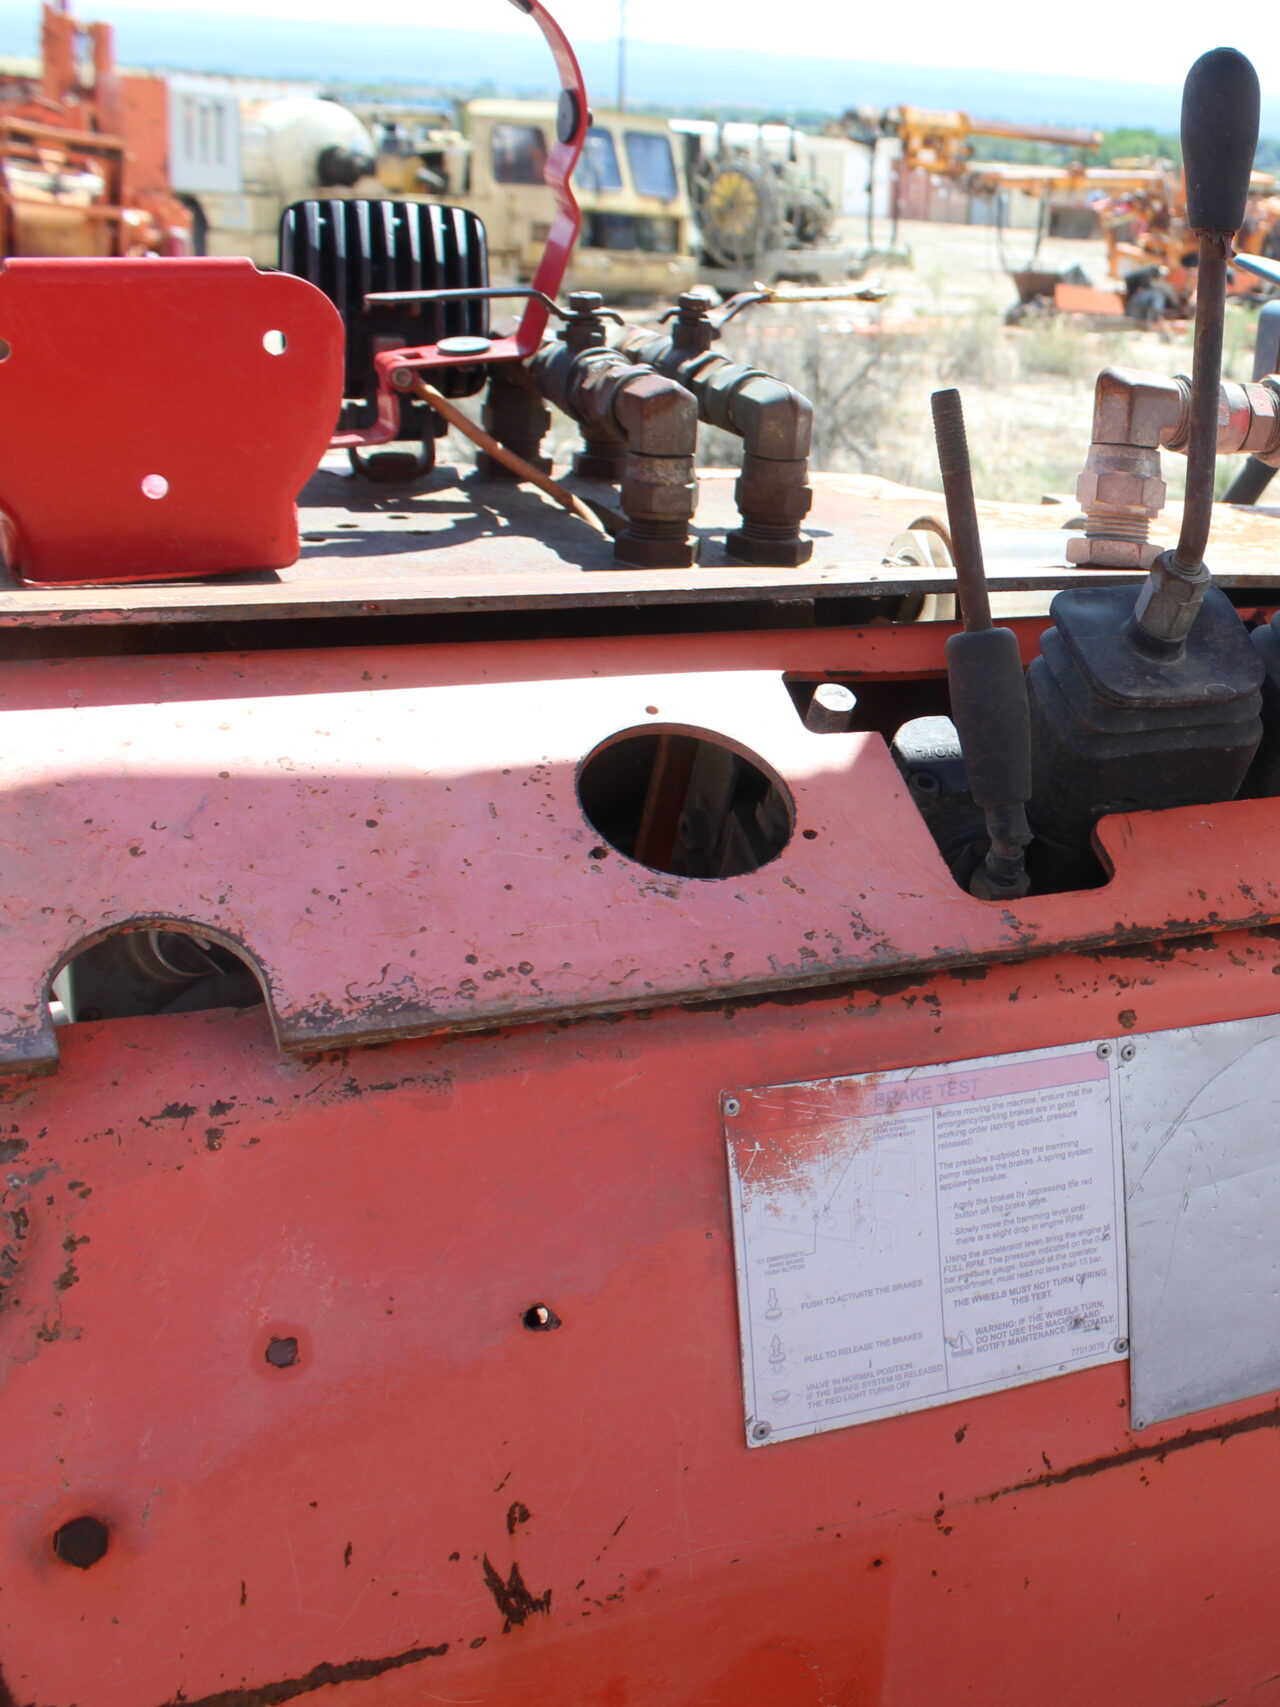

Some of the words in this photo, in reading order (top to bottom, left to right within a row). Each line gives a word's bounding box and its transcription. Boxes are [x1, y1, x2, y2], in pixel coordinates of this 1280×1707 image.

[873, 1084, 932, 1107] BRAKE
[936, 1077, 979, 1098] TEST
[936, 1108, 961, 1119] Before
[963, 1103, 990, 1116] moving
[991, 1101, 1004, 1110] the
[1066, 1089, 1079, 1098] that
[1080, 1086, 1093, 1095] the
[936, 1111, 1008, 1130] emergency/parking
[1009, 1107, 1033, 1117] brakes
[1048, 1103, 1056, 1111] in
[1057, 1100, 1076, 1110] good
[937, 1128, 966, 1141] working
[967, 1123, 988, 1134] order
[989, 1119, 1015, 1132] (spring
[1046, 1110, 1078, 1122] pressure
[937, 1159, 953, 1170] The
[954, 1154, 988, 1168] pressure
[989, 1148, 1020, 1162] supplied
[1020, 1146, 1030, 1157] by
[1031, 1144, 1044, 1153] the
[1044, 1138, 1079, 1152] tramming
[938, 1170, 961, 1182] pump
[961, 1163, 993, 1176] releases
[994, 1161, 1007, 1170] the
[1036, 1154, 1044, 1162] A
[1043, 1151, 1065, 1163] spring
[1067, 1146, 1093, 1159] system
[952, 1198, 974, 1212] Apply
[975, 1196, 988, 1206] the
[989, 1191, 1015, 1203] brakes
[1016, 1189, 1026, 1200] by
[1026, 1181, 1065, 1197] depressing
[1067, 1178, 1079, 1189] the
[1080, 1176, 1093, 1186] red
[968, 1176, 980, 1186] the
[954, 1208, 978, 1220] button
[979, 1206, 990, 1215] on
[991, 1203, 1003, 1213] the
[1004, 1199, 1026, 1210] brake
[954, 1223, 979, 1237] Slowly
[980, 1220, 1002, 1231] move
[1002, 1217, 1015, 1226] the
[1016, 1210, 1050, 1225] tramming
[1051, 1206, 1069, 1217] lever
[1071, 1203, 1086, 1213] until
[945, 1251, 967, 1265] Using
[968, 1249, 981, 1259] the
[982, 1240, 1023, 1256] accelerator
[1045, 1232, 1063, 1244] bring
[1064, 1229, 1077, 1239] the
[1077, 1225, 1102, 1238] engine
[955, 1234, 976, 1245] there
[977, 1232, 984, 1241] is
[992, 1227, 1012, 1240] slight
[1012, 1224, 1030, 1236] drop
[1031, 1222, 1038, 1231] in
[1039, 1218, 1064, 1230] engine
[943, 1262, 964, 1274] FULL
[988, 1253, 1003, 1265] The
[1004, 1249, 1036, 1263] pressure
[1037, 1241, 1069, 1255] indicated
[1070, 1239, 1080, 1248] on
[1081, 1236, 1093, 1246] the
[1094, 1232, 1111, 1243] 0-5
[943, 1274, 955, 1284] bar
[957, 1267, 990, 1282] pressure
[1018, 1256, 1045, 1269] located
[1046, 1255, 1054, 1263] at
[1055, 1252, 1067, 1261] the
[1068, 1246, 1097, 1259] operator
[953, 1296, 969, 1307] THE
[971, 1288, 1007, 1304] WHEELS
[1009, 1283, 1032, 1296] MUST
[1033, 1279, 1051, 1290] NOT
[1052, 1274, 1074, 1286] TURN
[1075, 1267, 1106, 1282] DURING
[996, 1273, 1015, 1284] must
[1016, 1269, 1032, 1279] read
[1034, 1267, 1044, 1275] no
[1045, 1263, 1060, 1273] less
[1061, 1259, 1077, 1270] than
[800, 1298, 823, 1311] PUSH
[825, 1296, 835, 1305] TO
[836, 1288, 874, 1303] ACTIVATE
[874, 1285, 891, 1295] THE
[891, 1278, 923, 1292] BRAKES
[1010, 1294, 1029, 1306] THIS
[1031, 1288, 1053, 1301] TEST.
[974, 1319, 1016, 1335] WARNING:
[1018, 1317, 1025, 1325] IF
[1027, 1312, 1044, 1323] THE
[1045, 1304, 1079, 1319] WHEELS
[1080, 1298, 1104, 1312] TURN,
[975, 1334, 988, 1345] DO
[989, 1329, 1007, 1341] NOT
[1008, 1325, 1026, 1337] USE
[1026, 1321, 1043, 1332] THE
[1082, 1308, 1099, 1320] AND
[803, 1352, 824, 1364] PULL
[825, 1349, 837, 1359] TO
[837, 1341, 873, 1356] RELEASE
[875, 1337, 893, 1348] THE
[892, 1331, 923, 1344] BRAKES
[975, 1338, 1006, 1353] NOTIFY
[1007, 1325, 1065, 1346] MAINTENANCE
[805, 1379, 830, 1392] VALVE
[831, 1377, 840, 1386] IN
[841, 1369, 875, 1384] NORMAL
[876, 1361, 913, 1376] POSITION
[805, 1392, 813, 1401] IF
[814, 1388, 832, 1399] THE
[833, 1381, 860, 1395] BRAKE
[861, 1374, 894, 1389] SYSTEM
[895, 1372, 902, 1381] IS
[902, 1362, 944, 1379] RELEASED
[807, 1399, 824, 1410] THE
[824, 1394, 842, 1406] RED
[843, 1389, 866, 1401] LIGHT
[867, 1382, 895, 1396] TURNS
[896, 1378, 912, 1390] OFF
